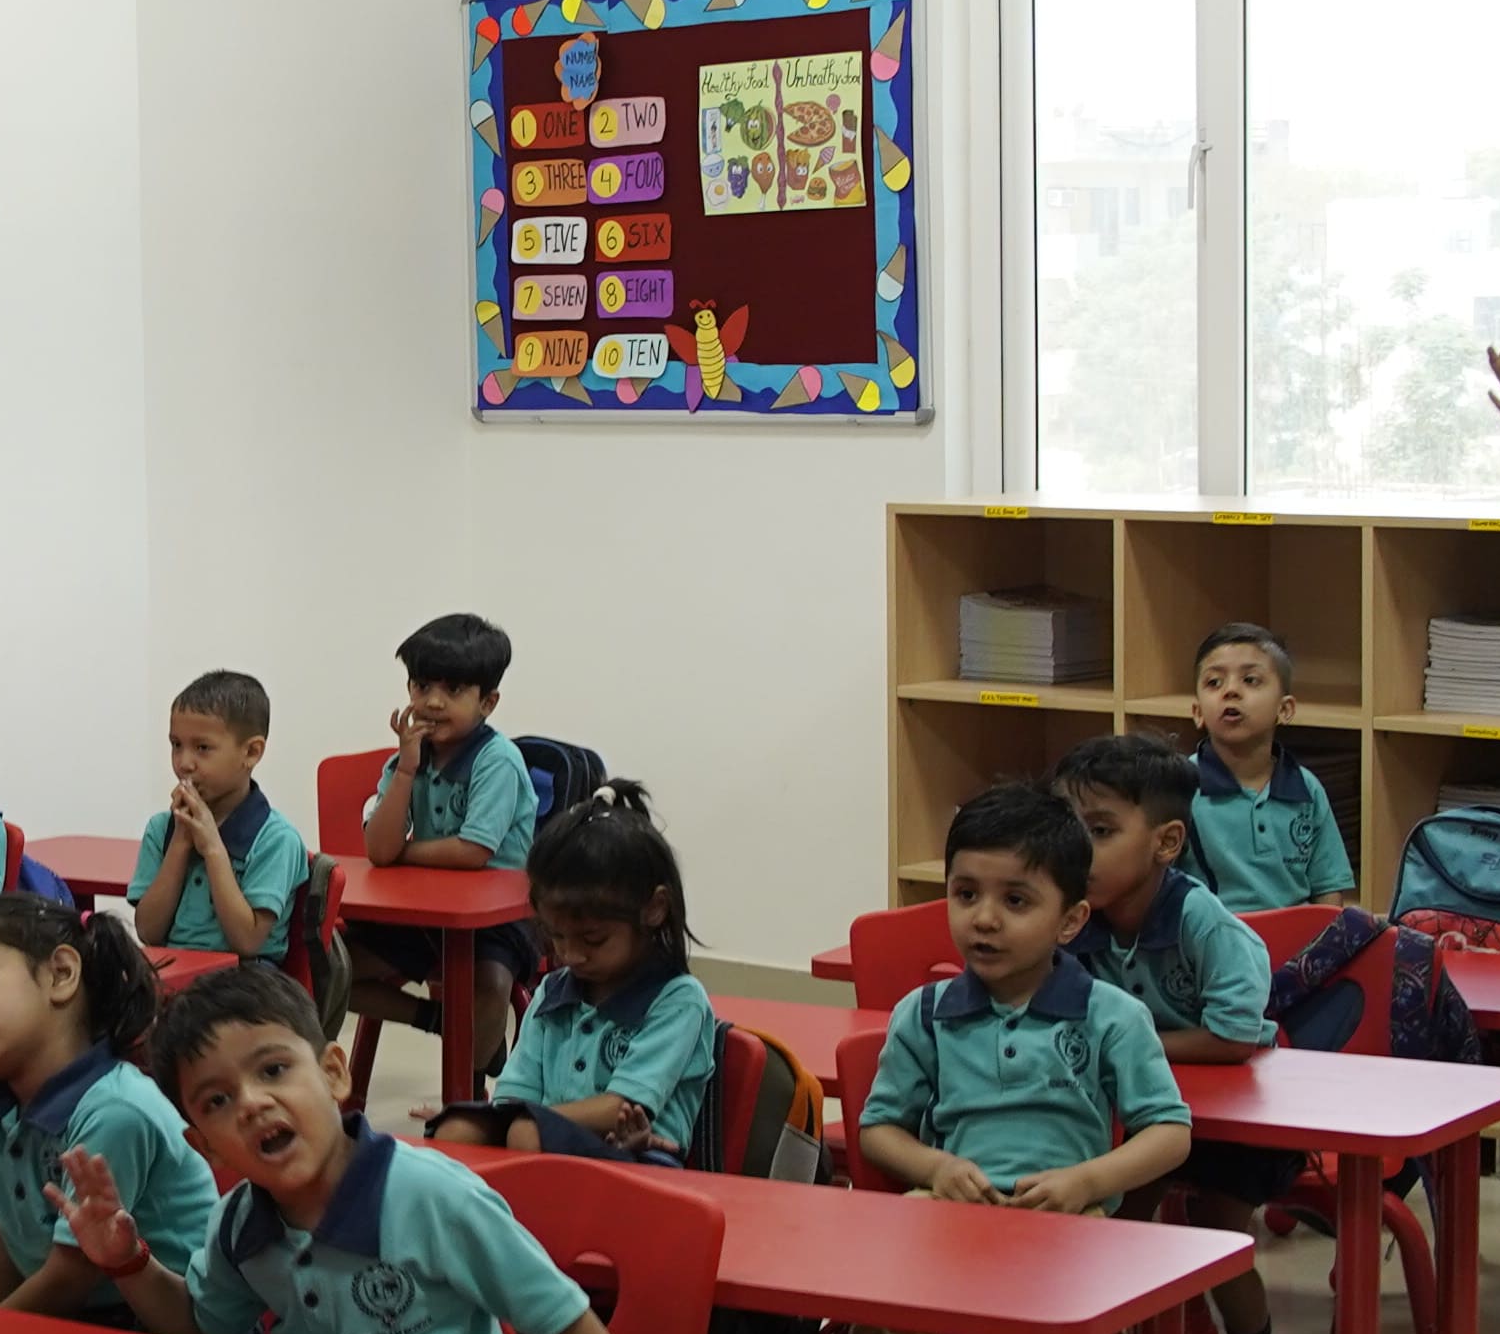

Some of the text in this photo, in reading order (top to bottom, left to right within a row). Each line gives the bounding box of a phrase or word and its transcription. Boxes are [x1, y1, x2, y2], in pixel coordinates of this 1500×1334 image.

[543, 110, 578, 139] ONE
[600, 103, 658, 134] 2 TWO
[525, 162, 587, 195] 3 THREE
[600, 156, 663, 193] 4 FOUR
[523, 223, 580, 254] 5 FIVE
[606, 222, 665, 250] 6 SIX
[523, 284, 586, 309] 7 SEVEN
[605, 278, 666, 307] 8 EIGHT
[524, 338, 584, 368] 9 NINE
[602, 339, 662, 367] 10 TEN
